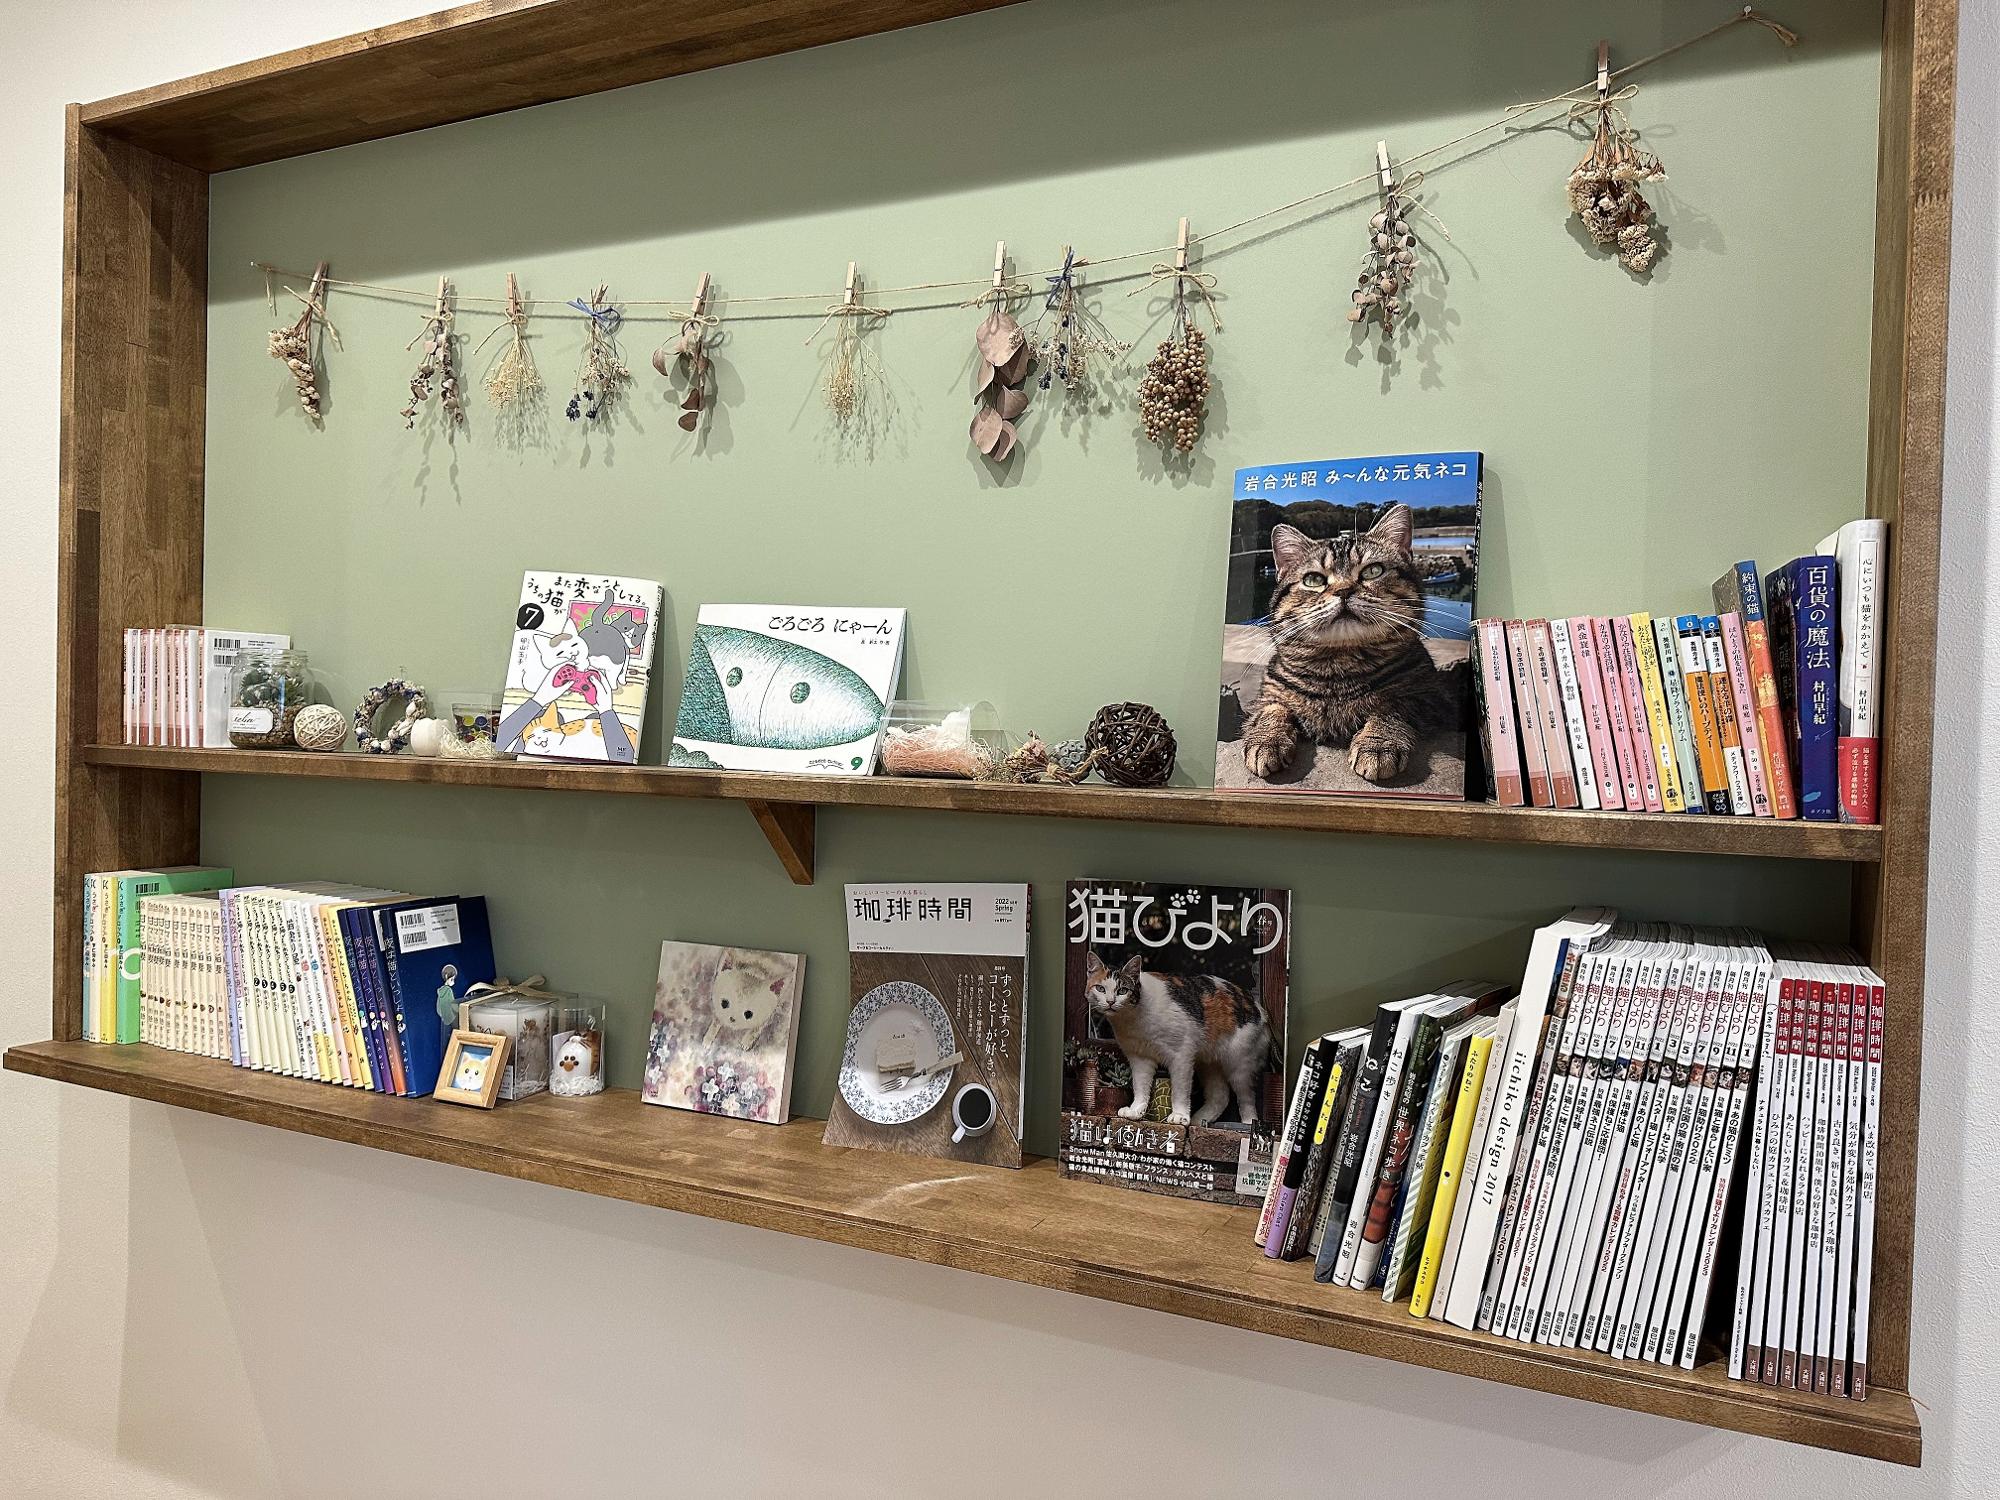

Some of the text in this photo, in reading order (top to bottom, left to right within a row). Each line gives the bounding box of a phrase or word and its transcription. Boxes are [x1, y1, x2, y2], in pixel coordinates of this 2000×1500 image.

[1243, 470, 1318, 492] 岩合光昭
[527, 578, 567, 616] うちの猫が
[554, 576, 647, 606] また変なことしてる。
[1742, 572, 1759, 615] 約束の猫
[1859, 558, 1873, 658] 心にいつも猫をかかえて
[524, 608, 539, 627] 7
[768, 616, 892, 635] ごろごろ にゃーん
[1804, 566, 1831, 670] 百貨の魔法
[1577, 623, 1591, 657] 黄金旋律
[1813, 681, 1826, 725] 村山早紀
[1858, 690, 1868, 720] 村山早紀
[851, 757, 864, 770] 9
[853, 897, 972, 923] 珈琲時間
[995, 905, 1014, 913] Spring
[1068, 888, 1284, 954] 猫びより
[998, 974, 1012, 1058] ずっとずっと、
[1569, 983, 1584, 1023] 猫びより
[1584, 983, 1601, 1024] 猫びより
[1597, 985, 1615, 1027] 猫びより
[1613, 986, 1630, 1028] 猫びより
[1629, 986, 1647, 1027] 猫びより
[1642, 987, 1659, 1029] 猫びより
[1659, 988, 1676, 1029] 猫びより
[1674, 985, 1692, 1026] 猫びより
[1687, 991, 1704, 1033] 猫びより
[1701, 991, 1719, 1032] 猫びより
[1716, 992, 1735, 1034] 猫びより
[1731, 992, 1749, 1034] 猫びより
[1747, 992, 1763, 1035] 猫びより
[985, 974, 998, 1077] コーヒーが好き。
[1578, 1037, 1585, 1045] 3
[1635, 1041, 1645, 1051] 11
[1669, 1040, 1676, 1048] 3
[1778, 999, 1791, 1052] 珈琲時間
[1792, 998, 1805, 1052] 珈琲時間
[1806, 1001, 1820, 1053] 珈琲時間
[1820, 1003, 1834, 1055] 珈琲時間
[1836, 1003, 1849, 1056] 珈琲時間
[1853, 1005, 1865, 1058] 珈琲時間
[1870, 1006, 1883, 1059] 珈琲時間
[1463, 1050, 1478, 1092] ふたりのねこ
[1682, 1046, 1690, 1054] 5
[1713, 1047, 1719, 1055] 9
[1726, 1047, 1736, 1055] 11
[1744, 1049, 1750, 1057] 1
[1360, 1056, 1379, 1092] ねこ
[1383, 1048, 1403, 1101] ねこ歩き
[1317, 1074, 1339, 1135] にゃんたま
[1538, 1095, 1557, 1148] みんなの推し猫
[1573, 1098, 1587, 1130] 肉球礼賛
[1584, 1100, 1602, 1147] 最強ネコ伝説
[1616, 1101, 1630, 1134] 相棒は猫
[1069, 1118, 1180, 1154] 猫は働き者
[1482, 1051, 1527, 1206] iichiko design 2017
[1547, 1096, 1573, 1178] 猫と一緒に生き残る防災
[1630, 1107, 1646, 1148] あの人と猫
[1637, 1100, 1663, 1191] スター猫ビフォーアフター
[1657, 1107, 1677, 1164] 開校!ねこ大学
[1688, 1108, 1708, 1165] 猫助け2022
[1702, 1109, 1723, 1173] 猫と暮らしたい家
[1722, 1111, 1739, 1165] あの猫のヒミツ
[1752, 1099, 1766, 1176] ナチュラルに暮らしたい!
[1343, 1133, 1359, 1168] 岩合光昭
[1763, 1113, 1781, 1230] ひみつの庭カフェ、テラスカフェ
[1845, 1121, 1859, 1217] 気分が変わる郊外カフェ
[1863, 1123, 1876, 1204] いま改めて、師匠店。
[1342, 1219, 1358, 1259] 岩合光昭
